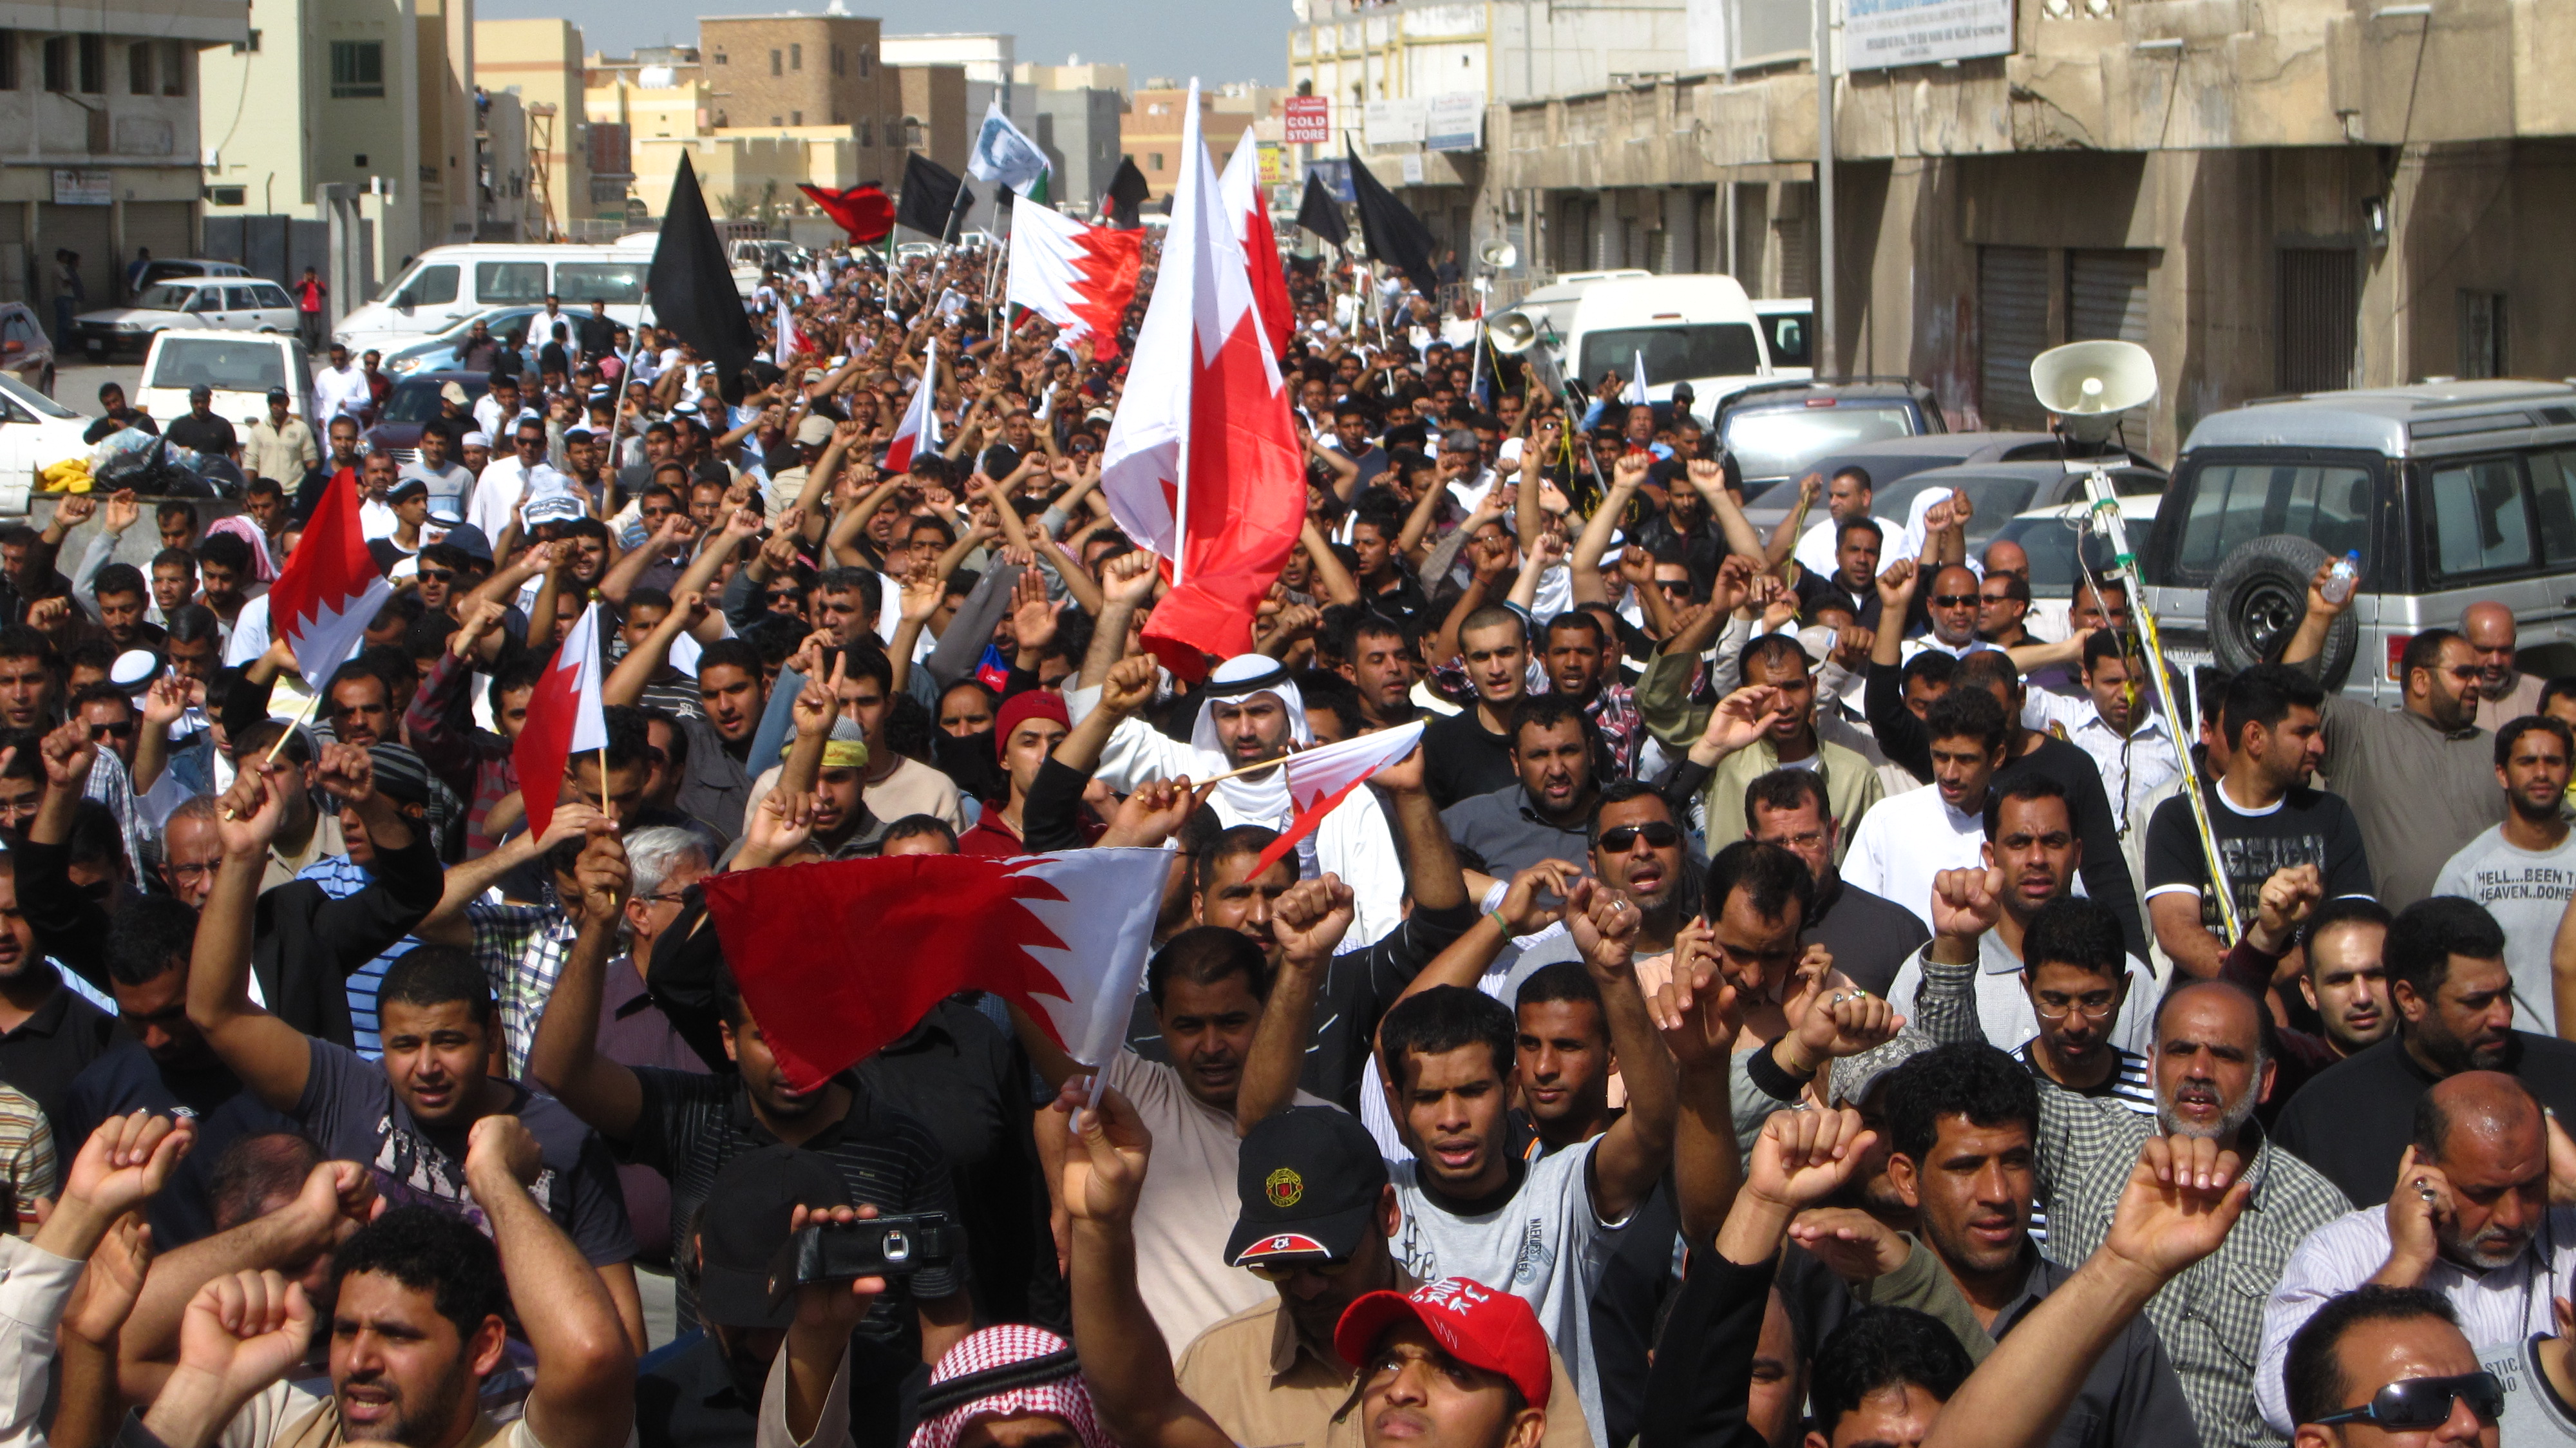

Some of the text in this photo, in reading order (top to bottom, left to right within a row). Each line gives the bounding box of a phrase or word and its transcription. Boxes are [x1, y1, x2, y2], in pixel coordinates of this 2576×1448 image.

[1287, 116, 1325, 127] COLD
[1287, 129, 1326, 140] STORE
[2477, 867, 2562, 886] HELL...BEEN
